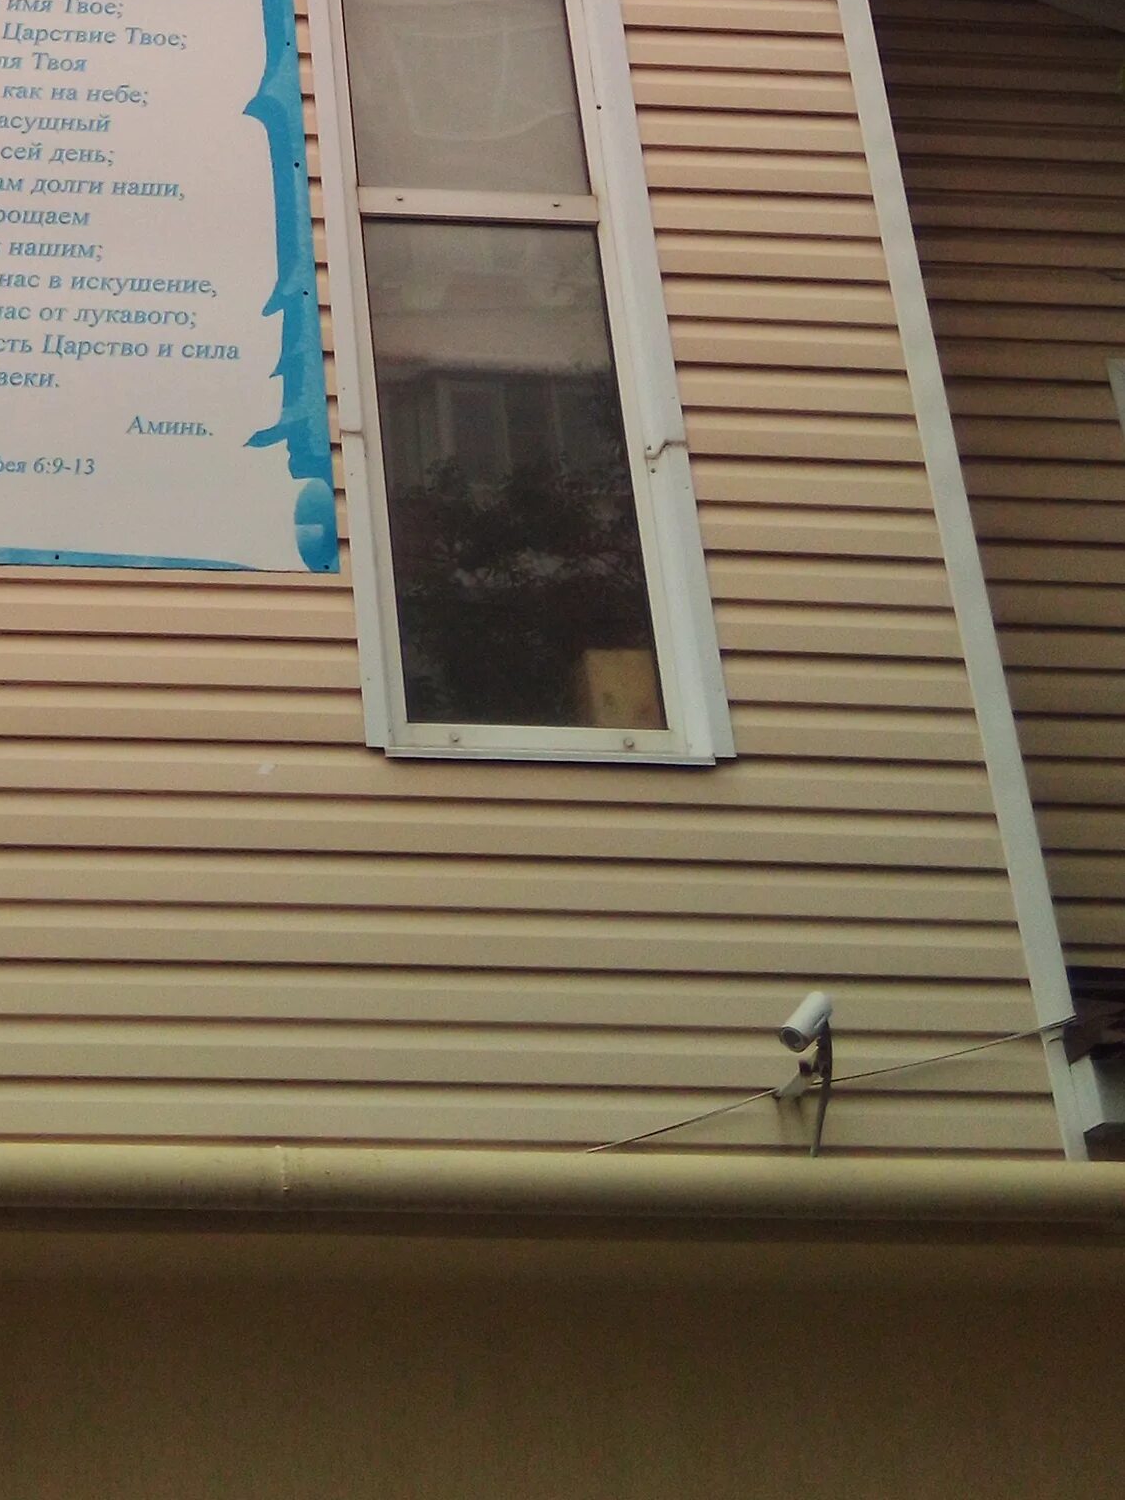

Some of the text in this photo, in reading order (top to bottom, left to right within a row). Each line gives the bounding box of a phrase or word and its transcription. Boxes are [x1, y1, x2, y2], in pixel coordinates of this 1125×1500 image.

[1, 21, 117, 46] Царствие
[124, 26, 187, 51] Твое;
[32, 51, 88, 73] Твоя
[2, 85, 43, 100] как
[50, 87, 78, 102] на
[86, 84, 149, 107] небе;
[0, 141, 43, 161] сей
[48, 147, 114, 167] день;
[29, 178, 105, 196] долги
[111, 181, 186, 202] наши,
[8, 241, 104, 262] нашим;
[47, 275, 63, 290] в
[70, 275, 218, 298] искушение,
[38, 306, 67, 322] от
[72, 308, 197, 330] лукавого;
[41, 333, 150, 361] Царство
[156, 343, 174, 358] и
[180, 343, 241, 361] сила
[126, 414, 214, 437] Аминь.
[32, 456, 96, 476] 6:9-13
